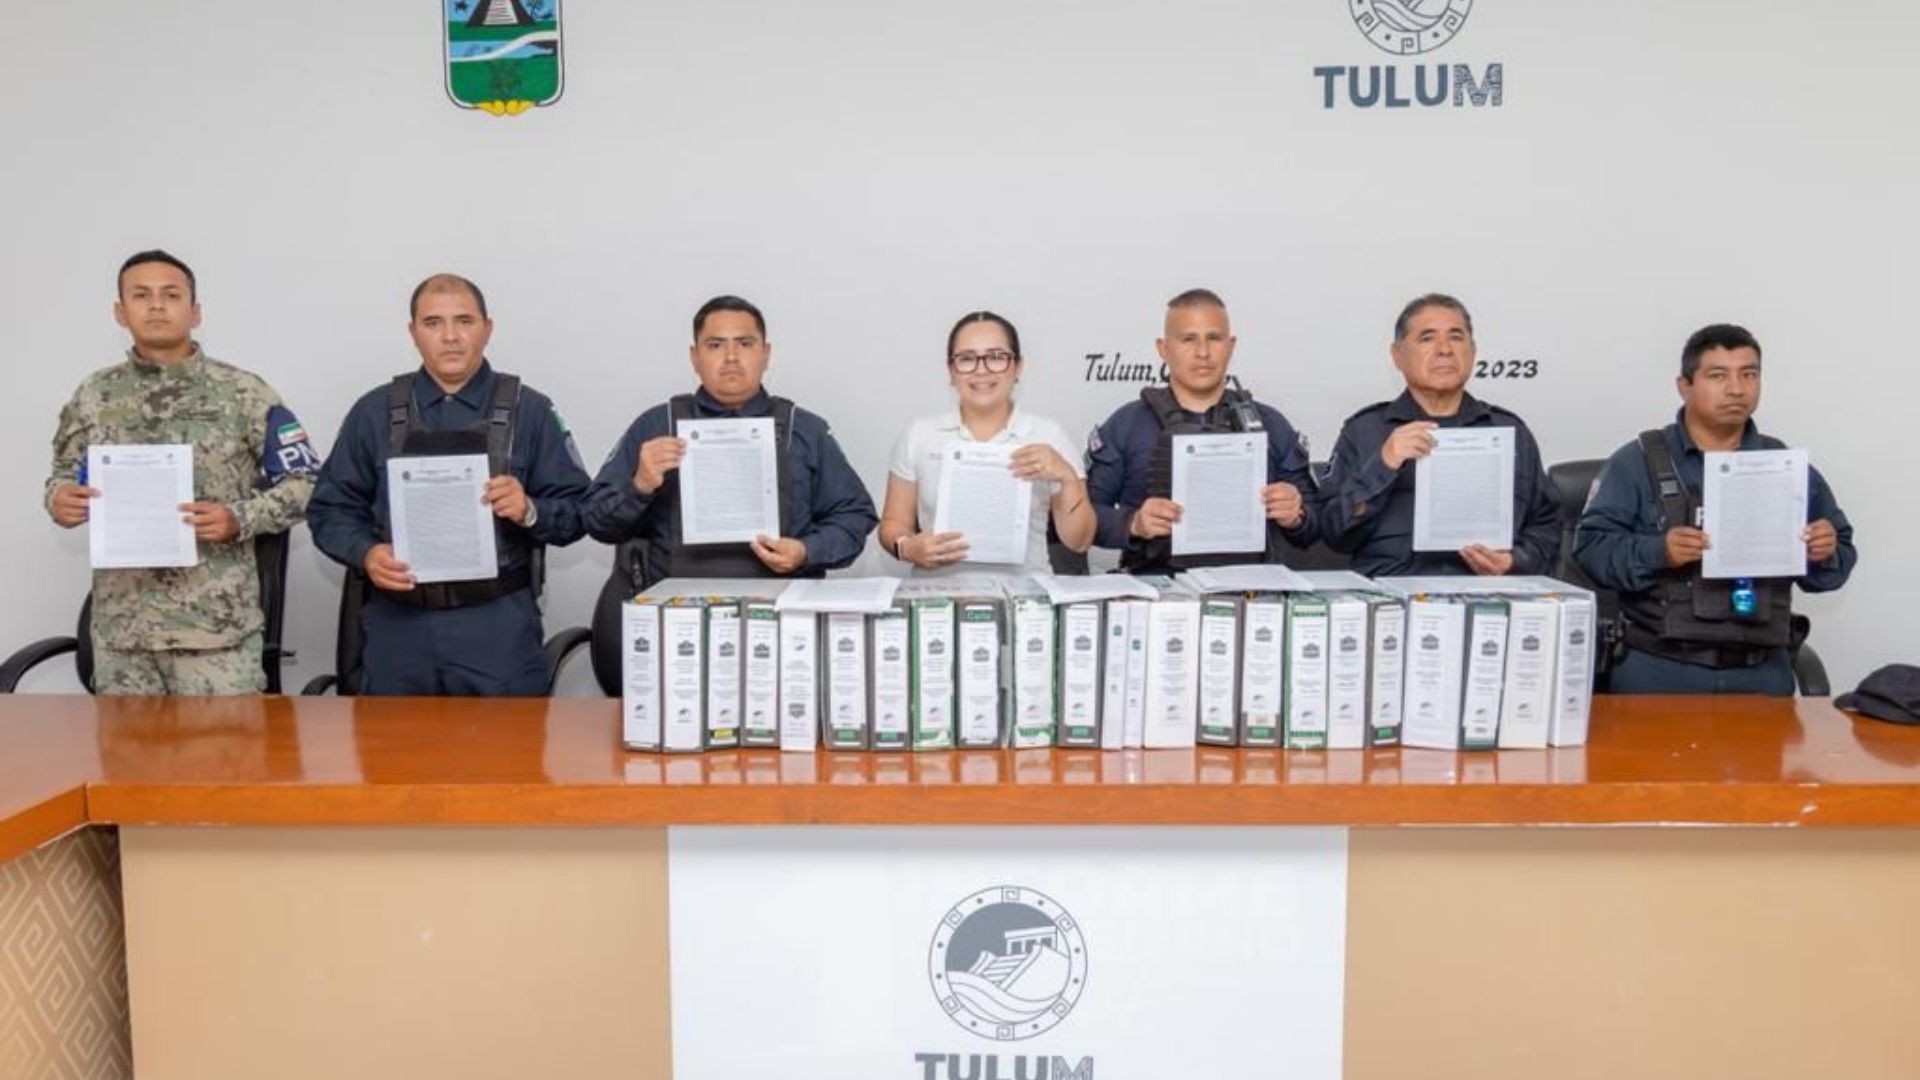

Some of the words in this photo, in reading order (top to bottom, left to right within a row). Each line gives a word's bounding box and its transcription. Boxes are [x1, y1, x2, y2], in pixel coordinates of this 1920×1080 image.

[1313, 63, 1503, 109] TULUM
[1085, 352, 1157, 383] Tulum,
[1475, 359, 1538, 379] 2023
[915, 1053, 1094, 1080] TULUM
